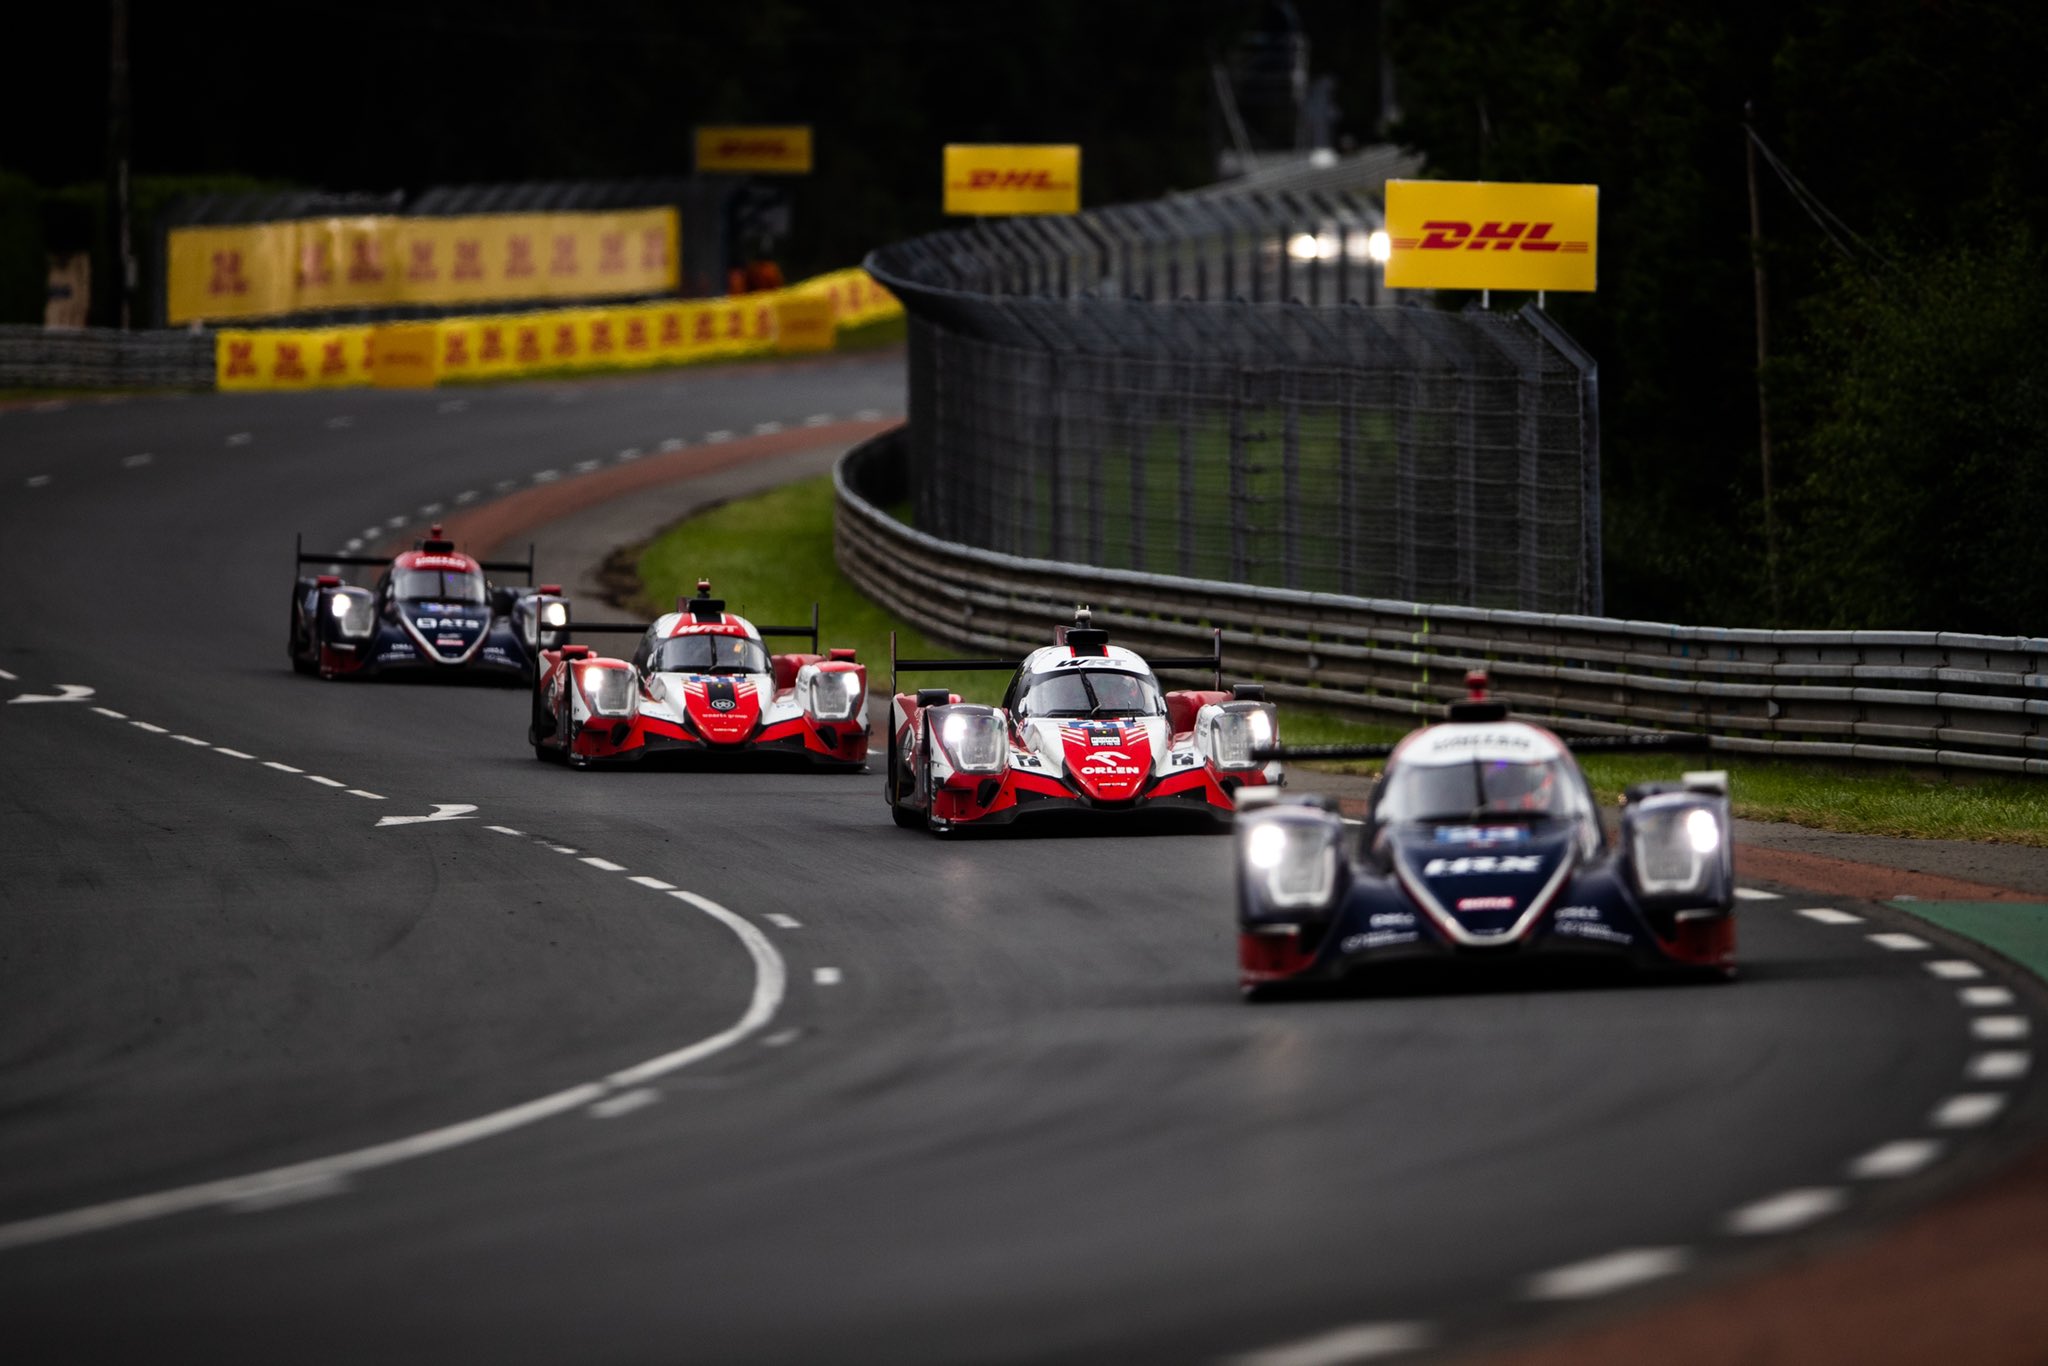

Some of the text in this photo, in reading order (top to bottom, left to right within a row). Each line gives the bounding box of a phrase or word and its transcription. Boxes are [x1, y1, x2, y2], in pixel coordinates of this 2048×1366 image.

[967, 169, 1053, 191] DHL
[1418, 220, 1560, 252] DHL
[677, 624, 739, 634] WRT
[1056, 659, 1127, 668] WRT
[1078, 719, 1127, 729] 41
[1081, 766, 1140, 775] ORLEN
